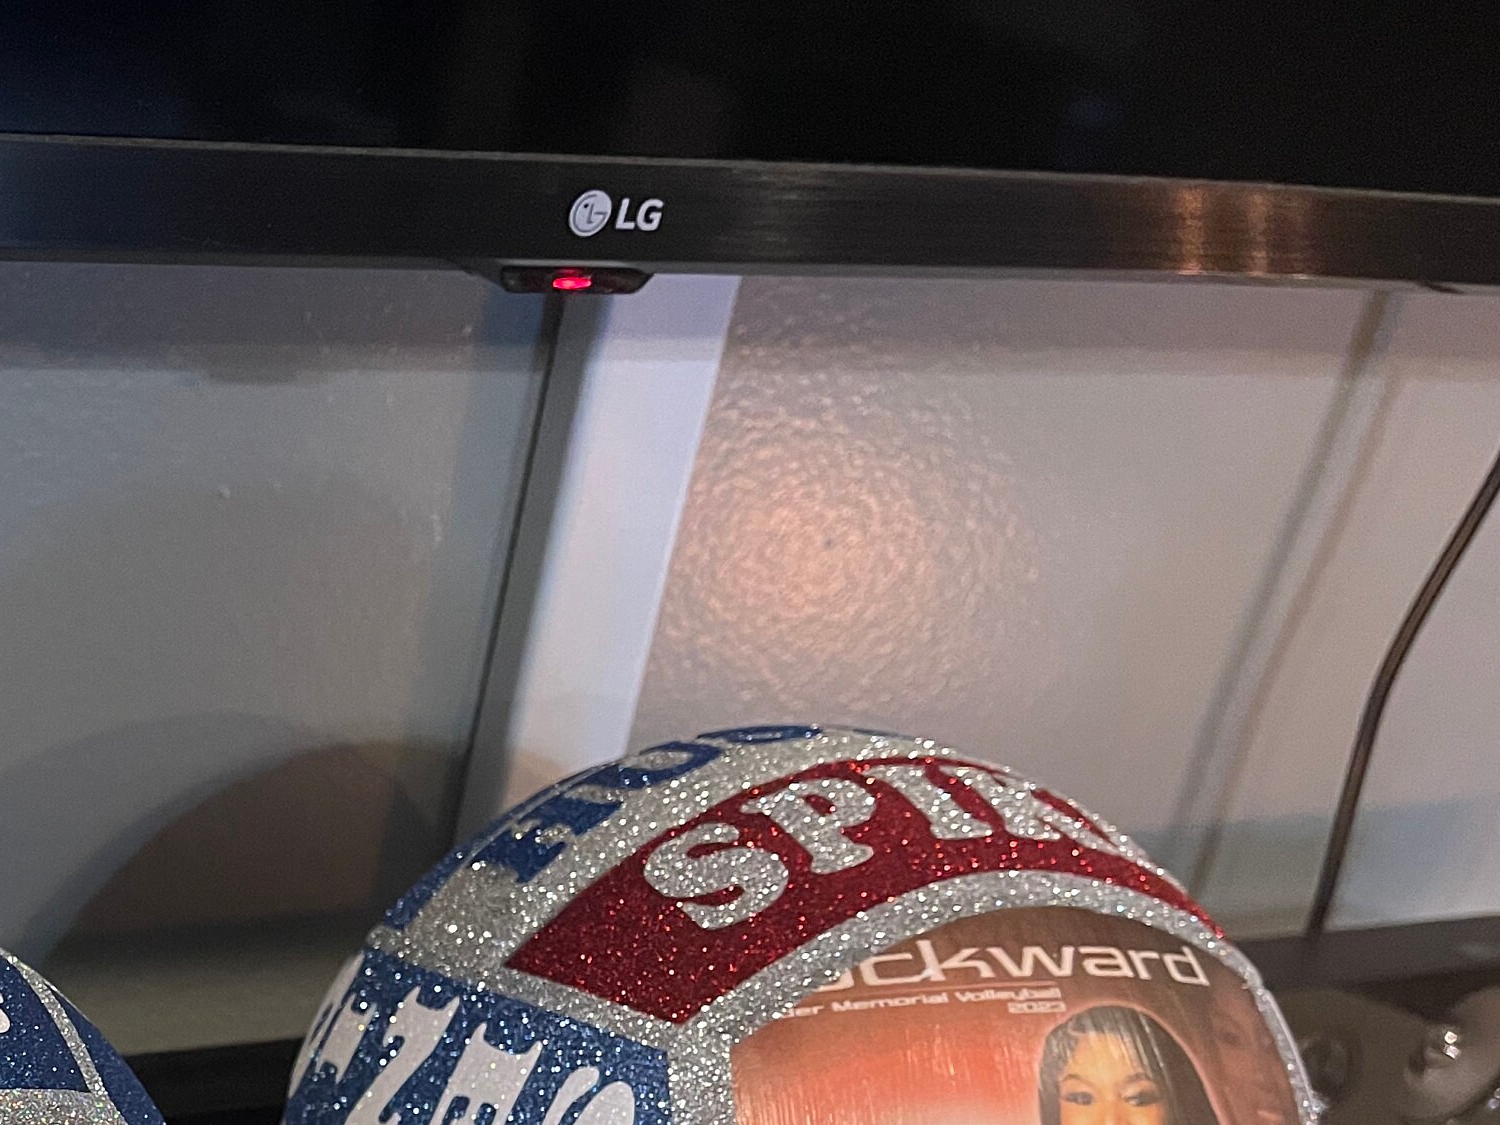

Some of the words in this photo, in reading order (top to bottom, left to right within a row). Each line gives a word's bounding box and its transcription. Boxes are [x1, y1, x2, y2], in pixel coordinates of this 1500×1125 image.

[615, 198, 664, 231] LG
[643, 763, 1142, 930] SPIK
[818, 939, 1210, 992] ckward
[831, 991, 949, 1013] Memorial
